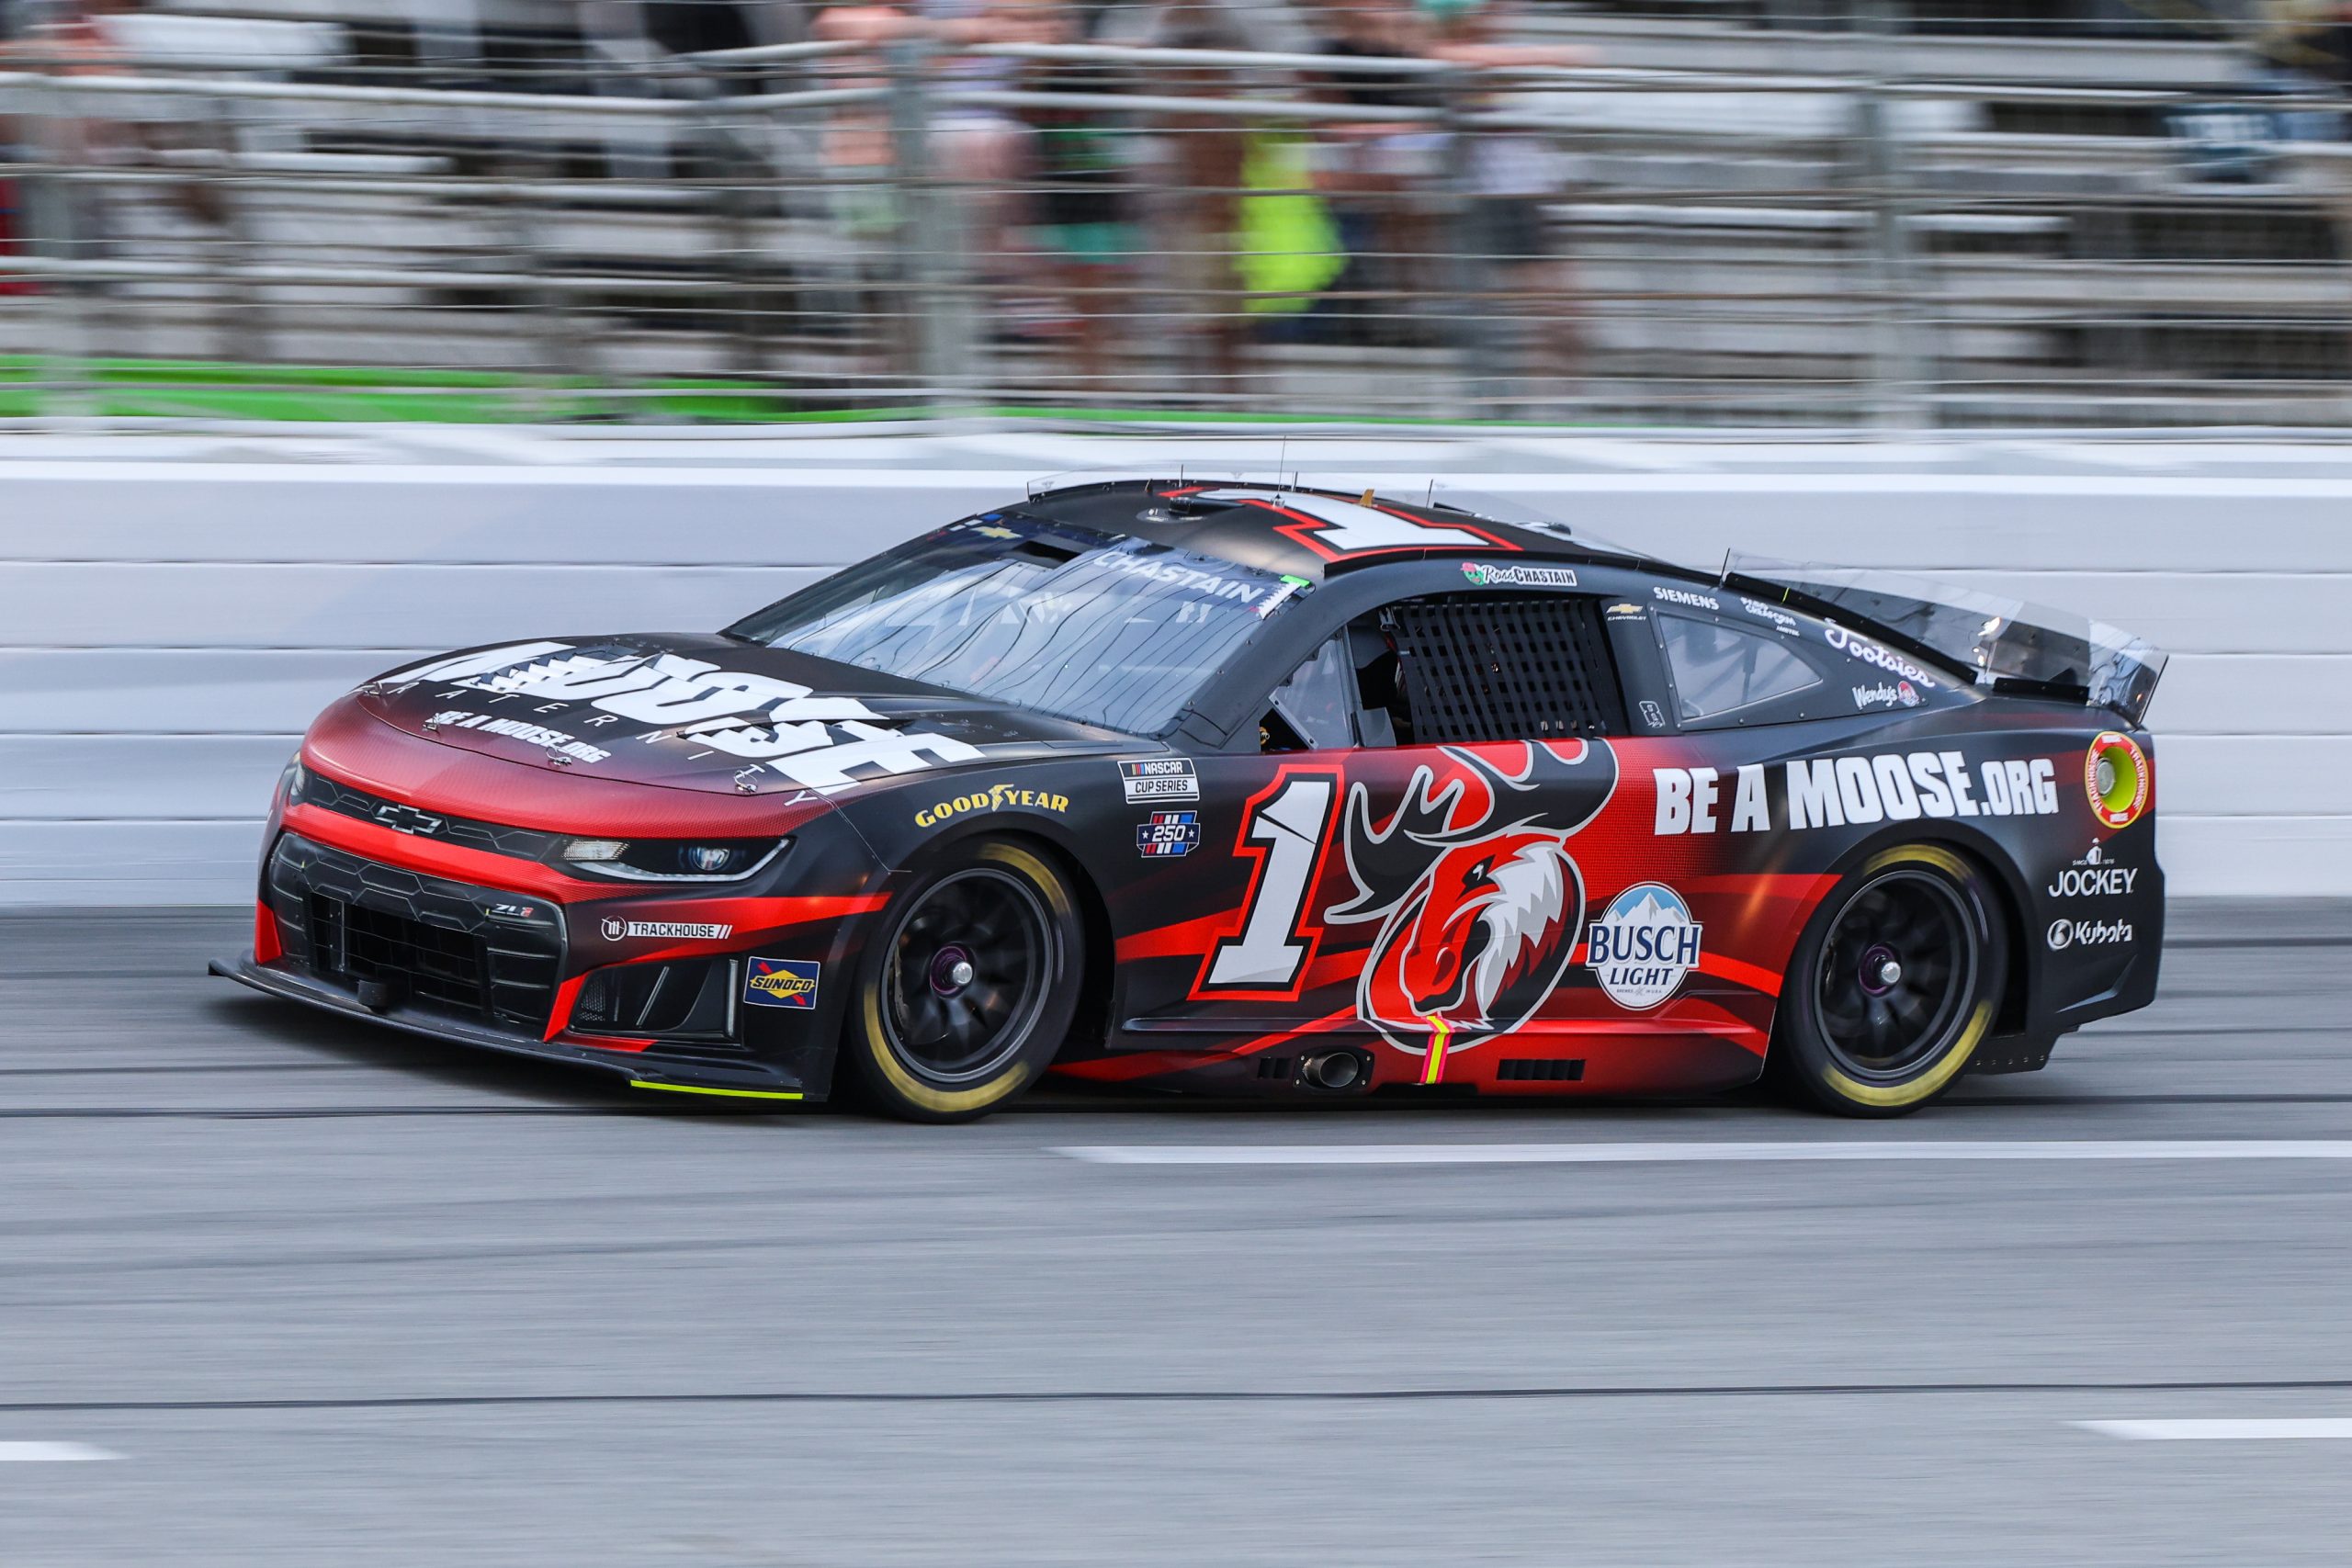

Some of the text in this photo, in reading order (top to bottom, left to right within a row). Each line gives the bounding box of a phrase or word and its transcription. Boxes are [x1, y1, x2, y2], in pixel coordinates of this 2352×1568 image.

[1093, 551, 1265, 604] CHASTAIN
[1653, 586, 1719, 611] SIEMENS
[1851, 681, 1898, 710] Wendy's
[455, 714, 492, 728] A
[1144, 761, 1184, 775] NASCAR
[1135, 779, 1189, 794] CUP SERIES
[1653, 750, 2060, 836] BE A MOOSE.ORG
[914, 787, 1069, 828] GOODYEAR
[1151, 824, 1187, 843] 250
[1205, 779, 1332, 985] 1
[2048, 867, 2139, 897] JOCKEY
[632, 922, 716, 937] TRACKHOUSE
[2075, 919, 2133, 945] Kubota
[1588, 925, 1700, 964] BUSCH
[752, 976, 812, 992] SUNOCO
[1608, 967, 1674, 986] LIGHT
